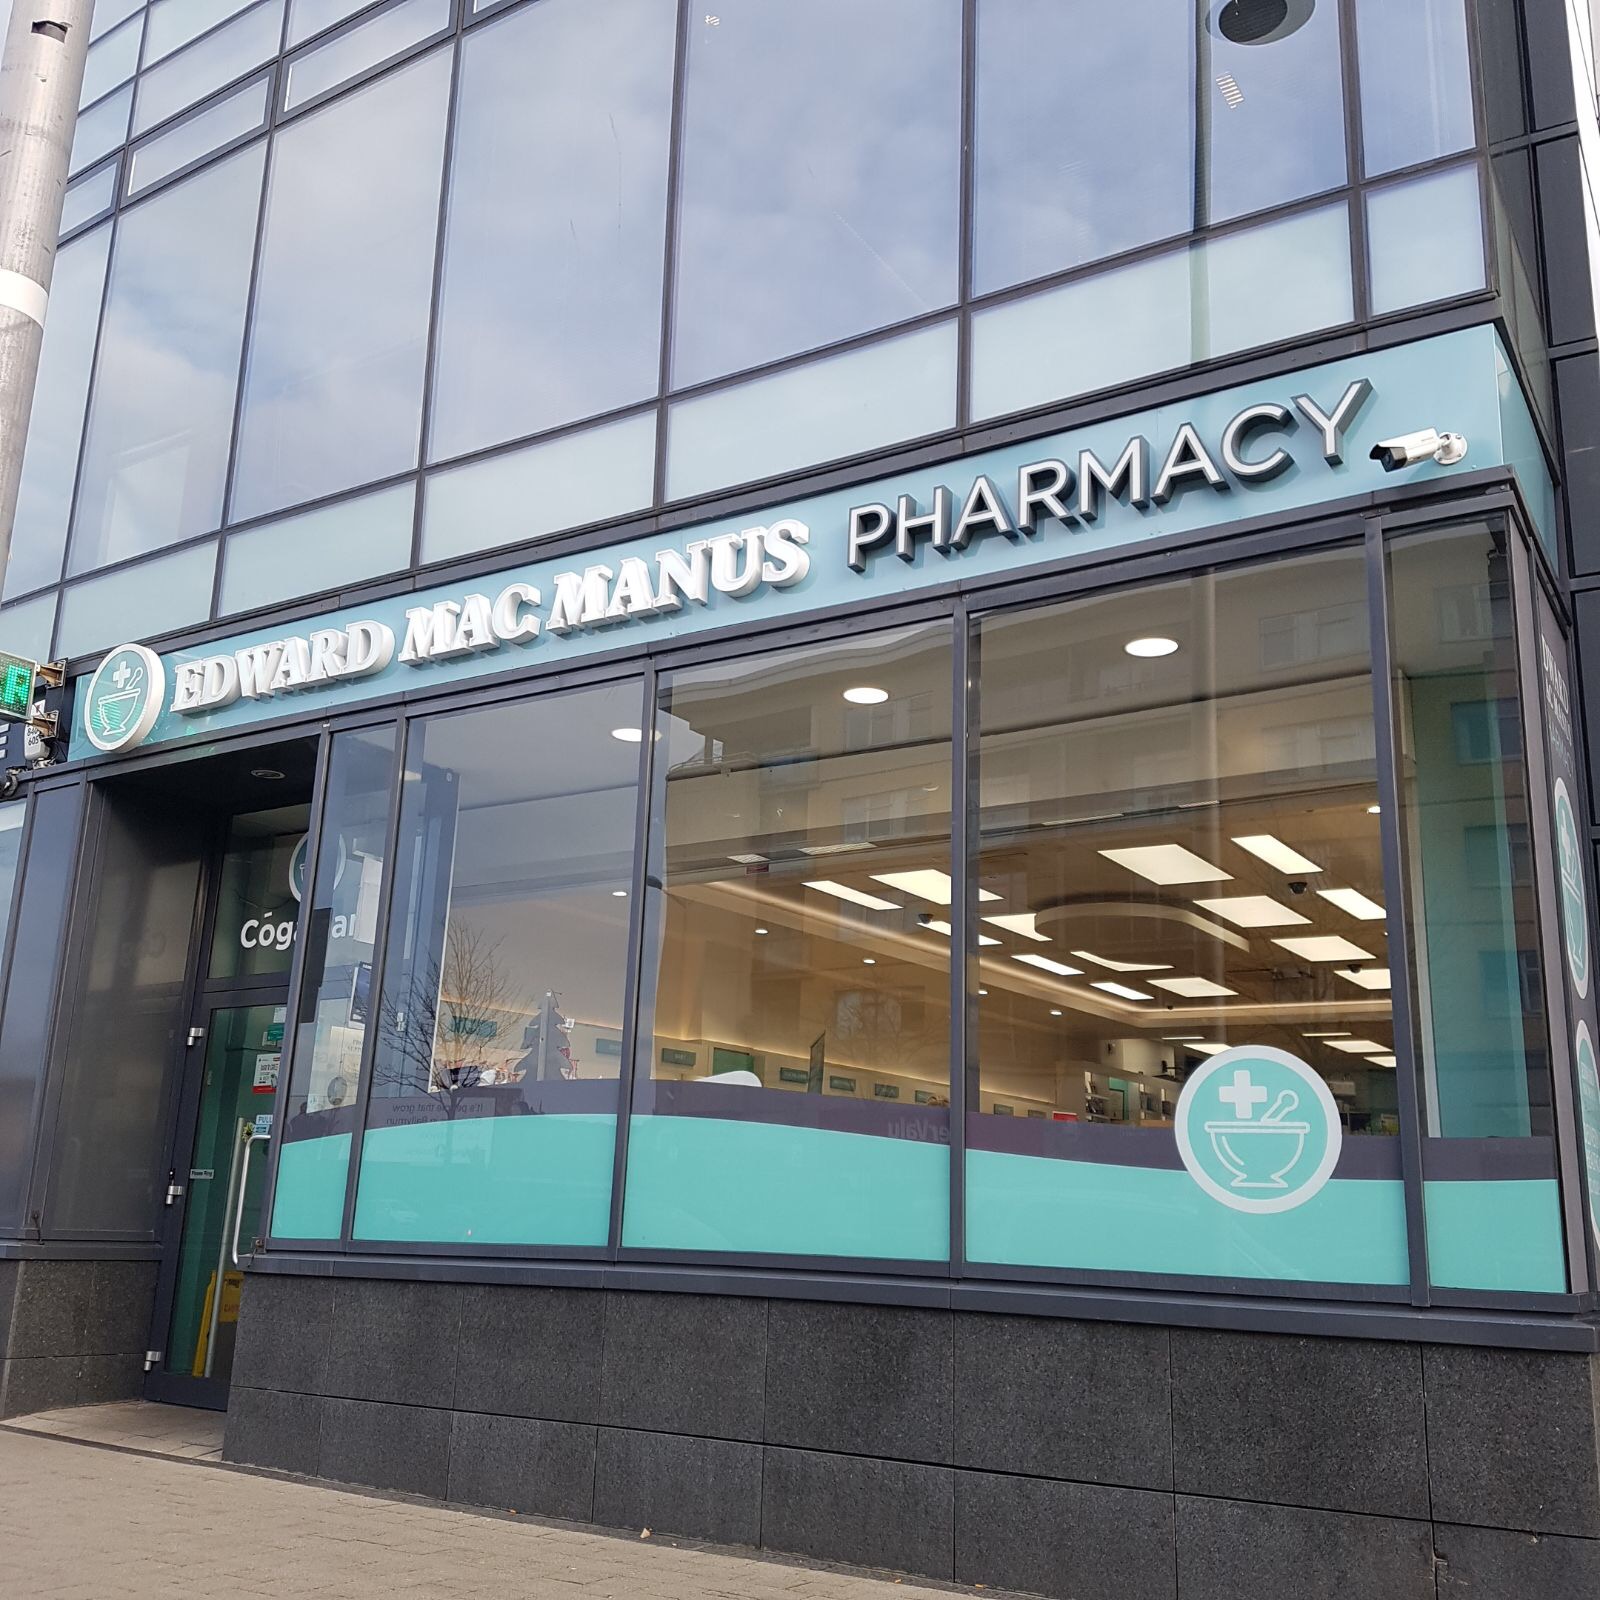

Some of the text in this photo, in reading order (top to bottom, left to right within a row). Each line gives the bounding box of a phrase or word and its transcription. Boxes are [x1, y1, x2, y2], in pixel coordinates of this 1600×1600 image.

[171, 378, 1377, 716] EDWARD MAC MANUS PHARMACY
